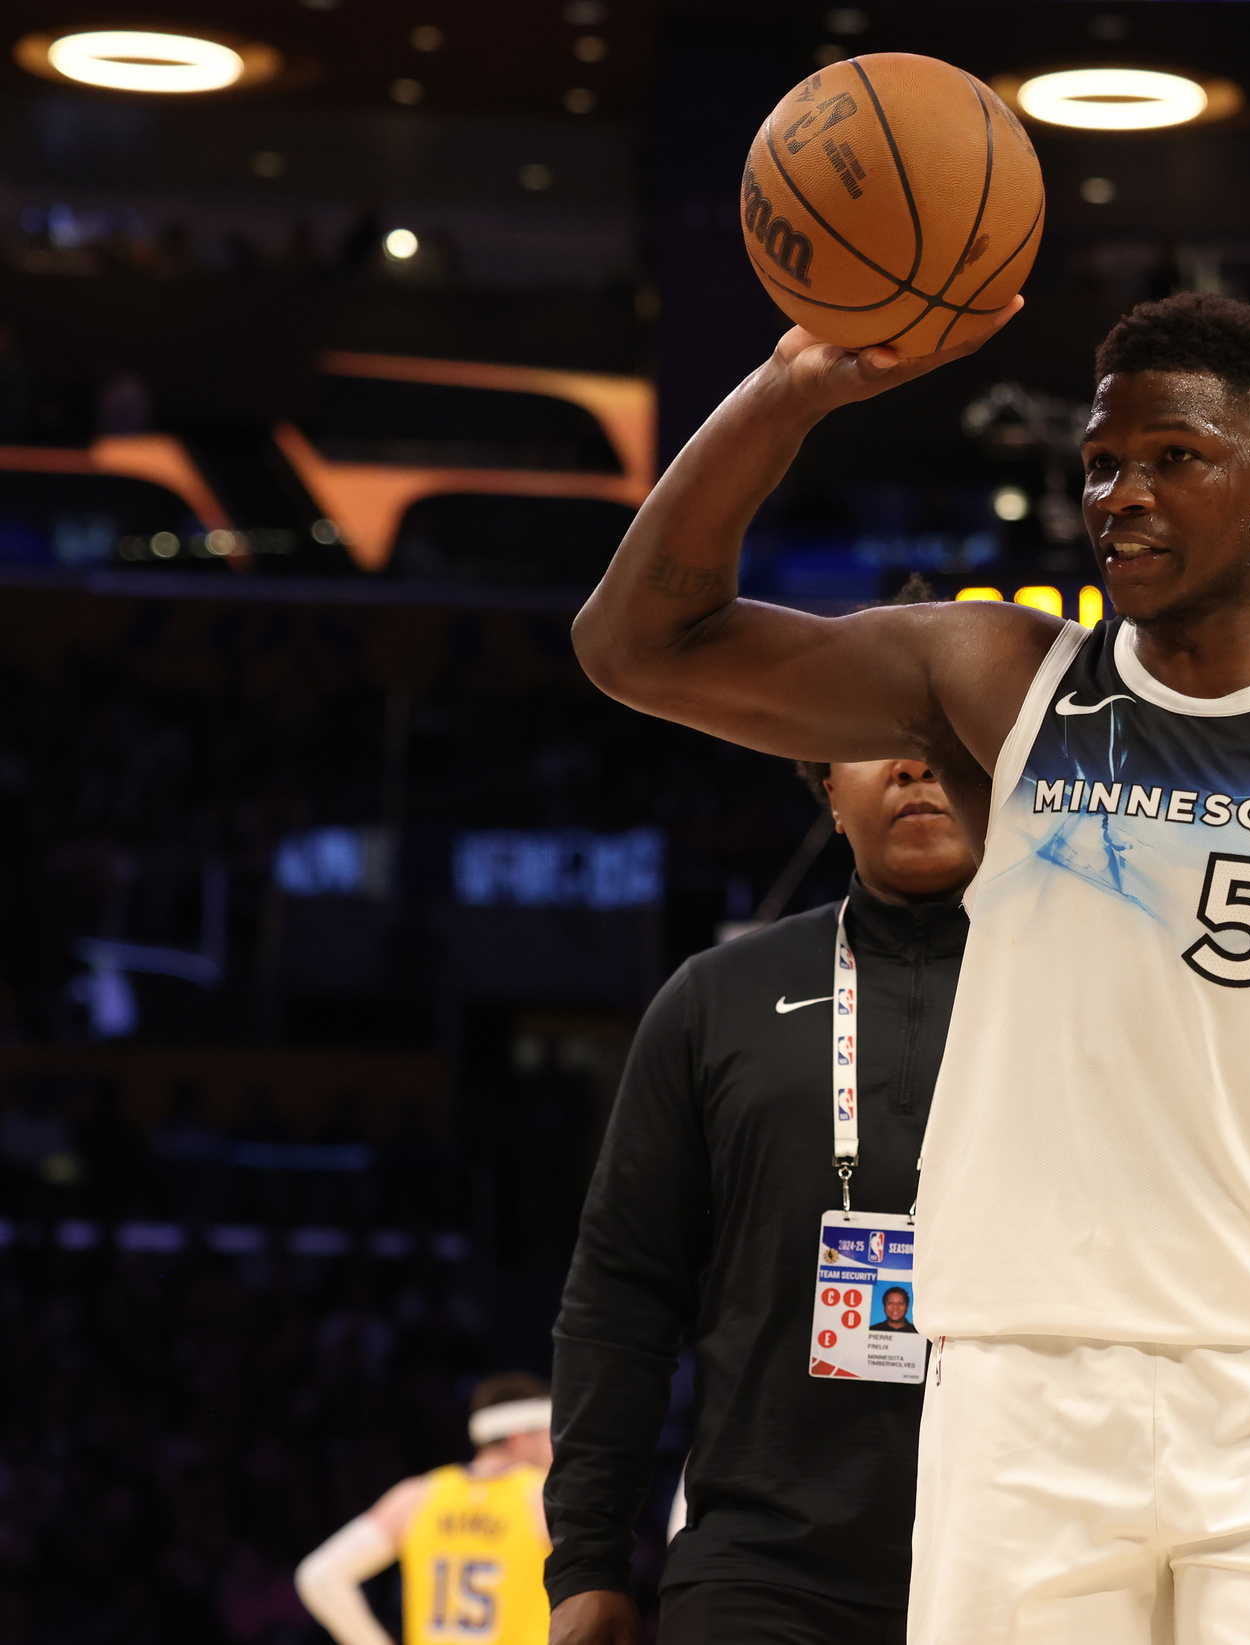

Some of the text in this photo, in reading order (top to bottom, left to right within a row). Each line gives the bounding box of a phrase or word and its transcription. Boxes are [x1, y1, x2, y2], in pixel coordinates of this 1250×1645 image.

[838, 1239, 914, 1255] 2024-25 SEASON
[819, 1269, 877, 1282] TEAM SECURITY
[850, 1292, 856, 1306] L
[824, 1332, 831, 1347] E
[867, 1360, 916, 1369] TIMBERWOLVES
[430, 1557, 499, 1634] 15
